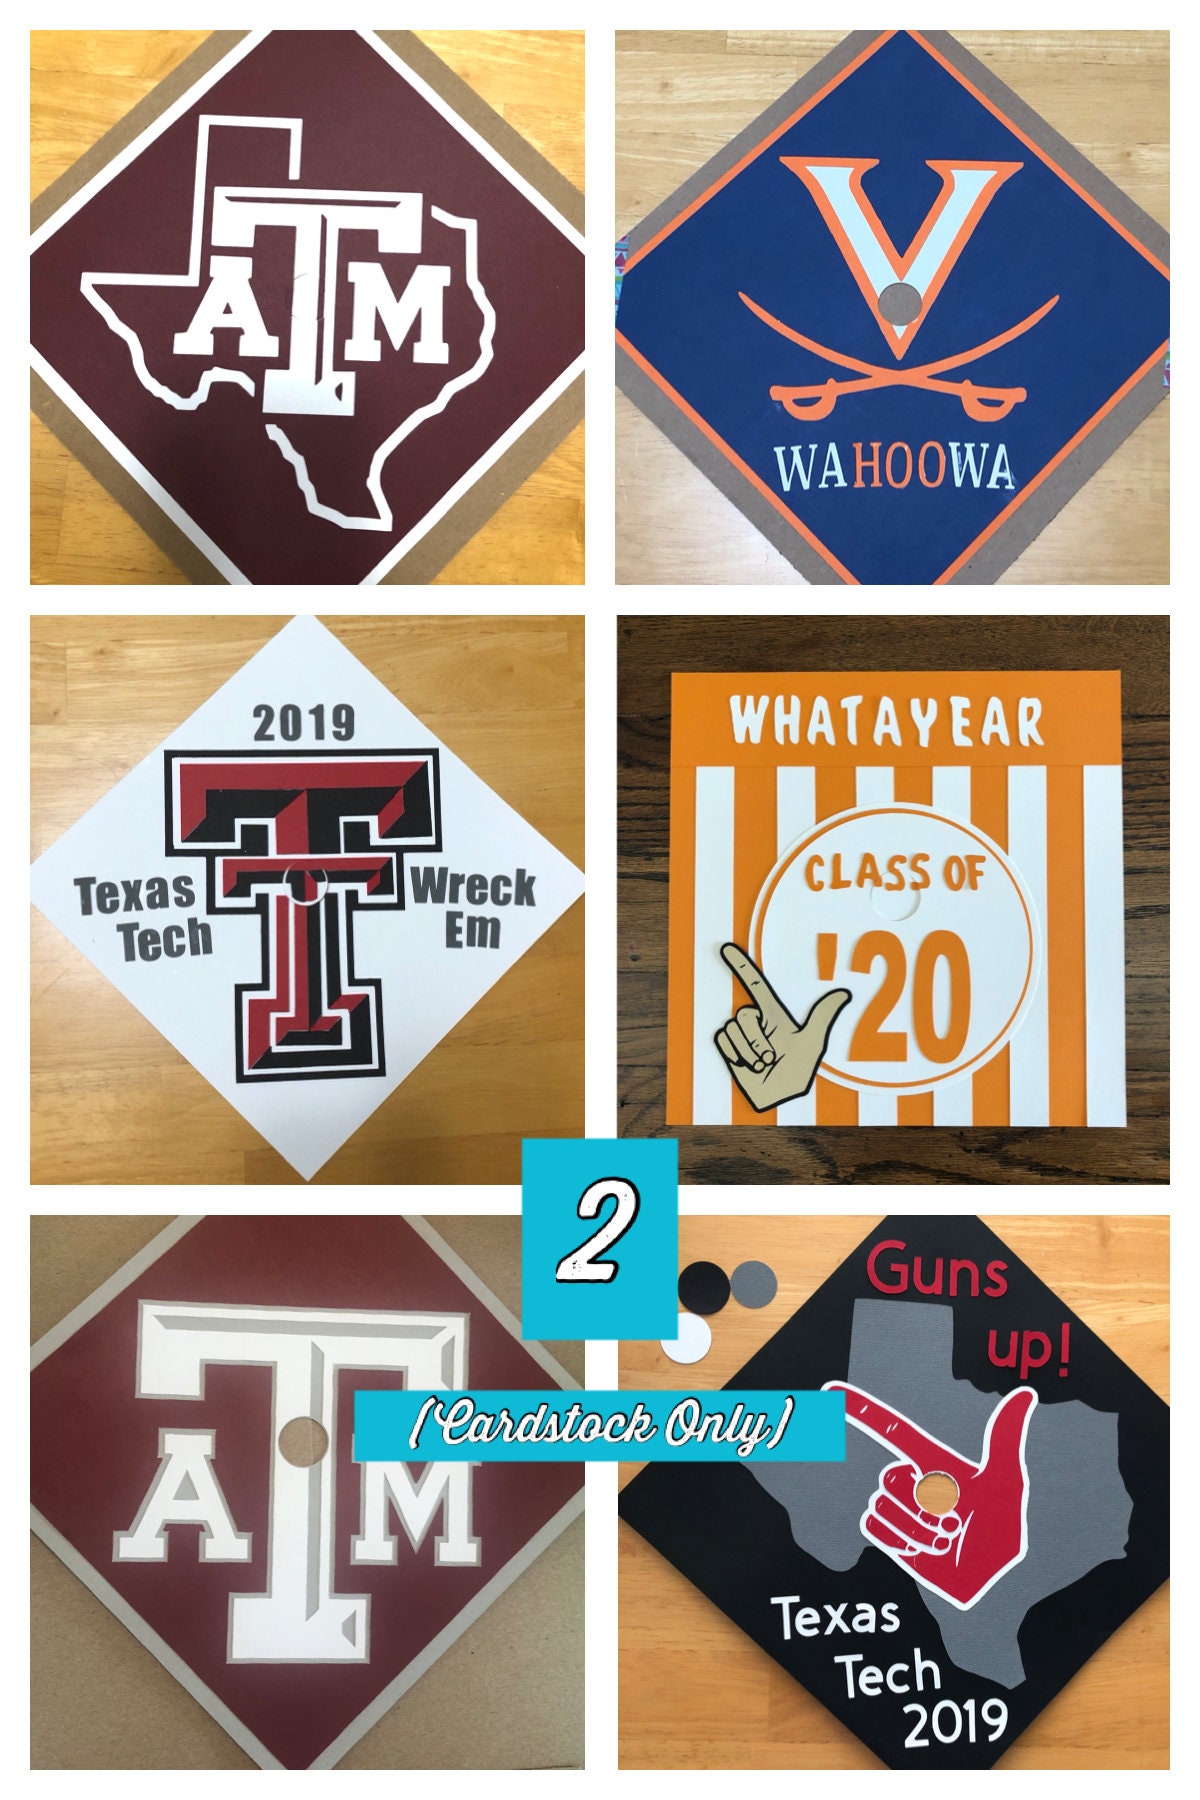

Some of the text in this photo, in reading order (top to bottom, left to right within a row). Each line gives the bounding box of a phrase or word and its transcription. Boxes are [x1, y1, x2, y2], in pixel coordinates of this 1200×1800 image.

[779, 156, 1025, 360] V
[773, 440, 1015, 492] WAHOOWA
[252, 703, 355, 742] 2019
[729, 694, 1045, 748] WHATAYEAR
[74, 874, 196, 916] Texas
[410, 866, 536, 908] Wreck
[804, 852, 987, 892] CLASS OF
[116, 917, 213, 962] Tech
[445, 911, 501, 949] Em
[815, 929, 972, 1064] '20
[866, 1239, 1009, 1298] Guns
[987, 1322, 1071, 1380] up!
[770, 1595, 900, 1640] Texas
[834, 1648, 942, 1698] Tech
[903, 1698, 1009, 1748] 2019
